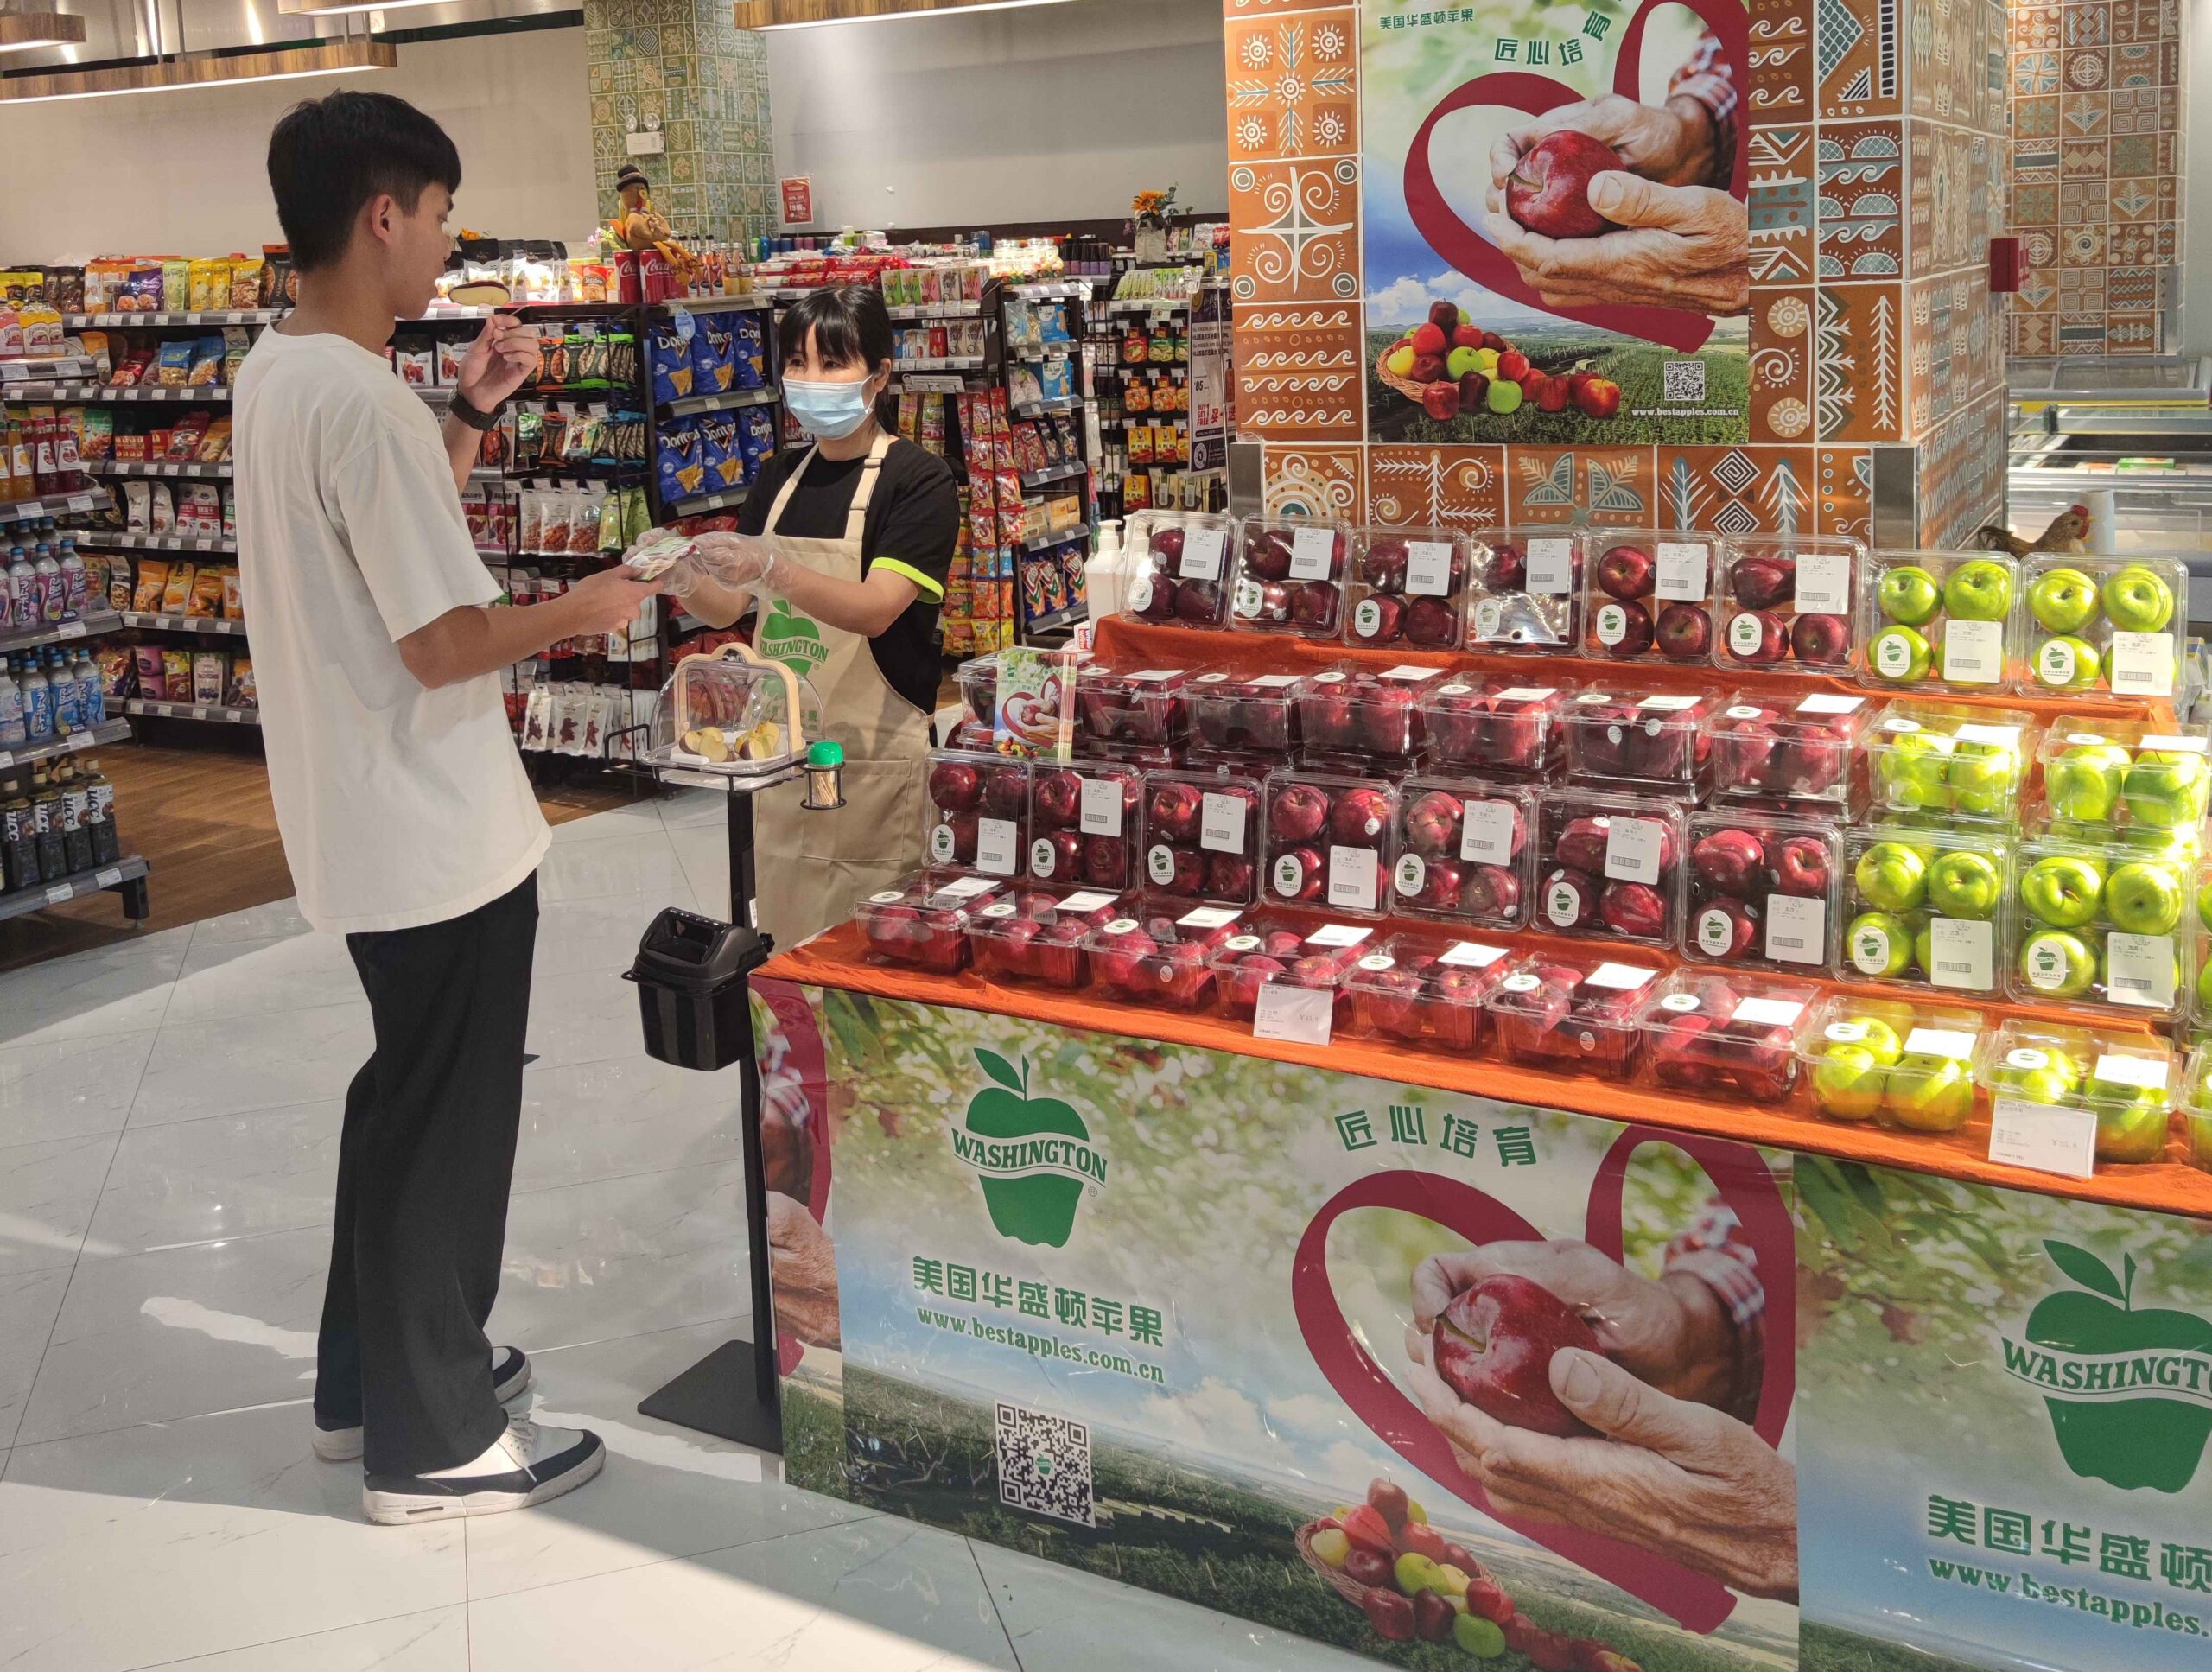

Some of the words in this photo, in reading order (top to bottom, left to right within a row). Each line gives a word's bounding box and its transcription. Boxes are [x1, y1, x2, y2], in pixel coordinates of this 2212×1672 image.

[1379, 8, 1475, 30] 美国华盛顿苹果
[1494, 10, 1612, 67] 匠心培育
[1631, 407, 1739, 417] www.bestapples.com.cn
[951, 1127, 1108, 1184] WASHINGTON
[1334, 1105, 1537, 1167] 匠心培育
[912, 1256, 1164, 1347] 美国华盛顿苹果
[917, 1306, 1165, 1383] www.bestapples.com.cn
[2001, 1337, 2212, 1394] WASHINGT
[1928, 1494, 2212, 1594] 美国华盛顿
[1928, 1557, 2212, 1638] wwwbestapples.
